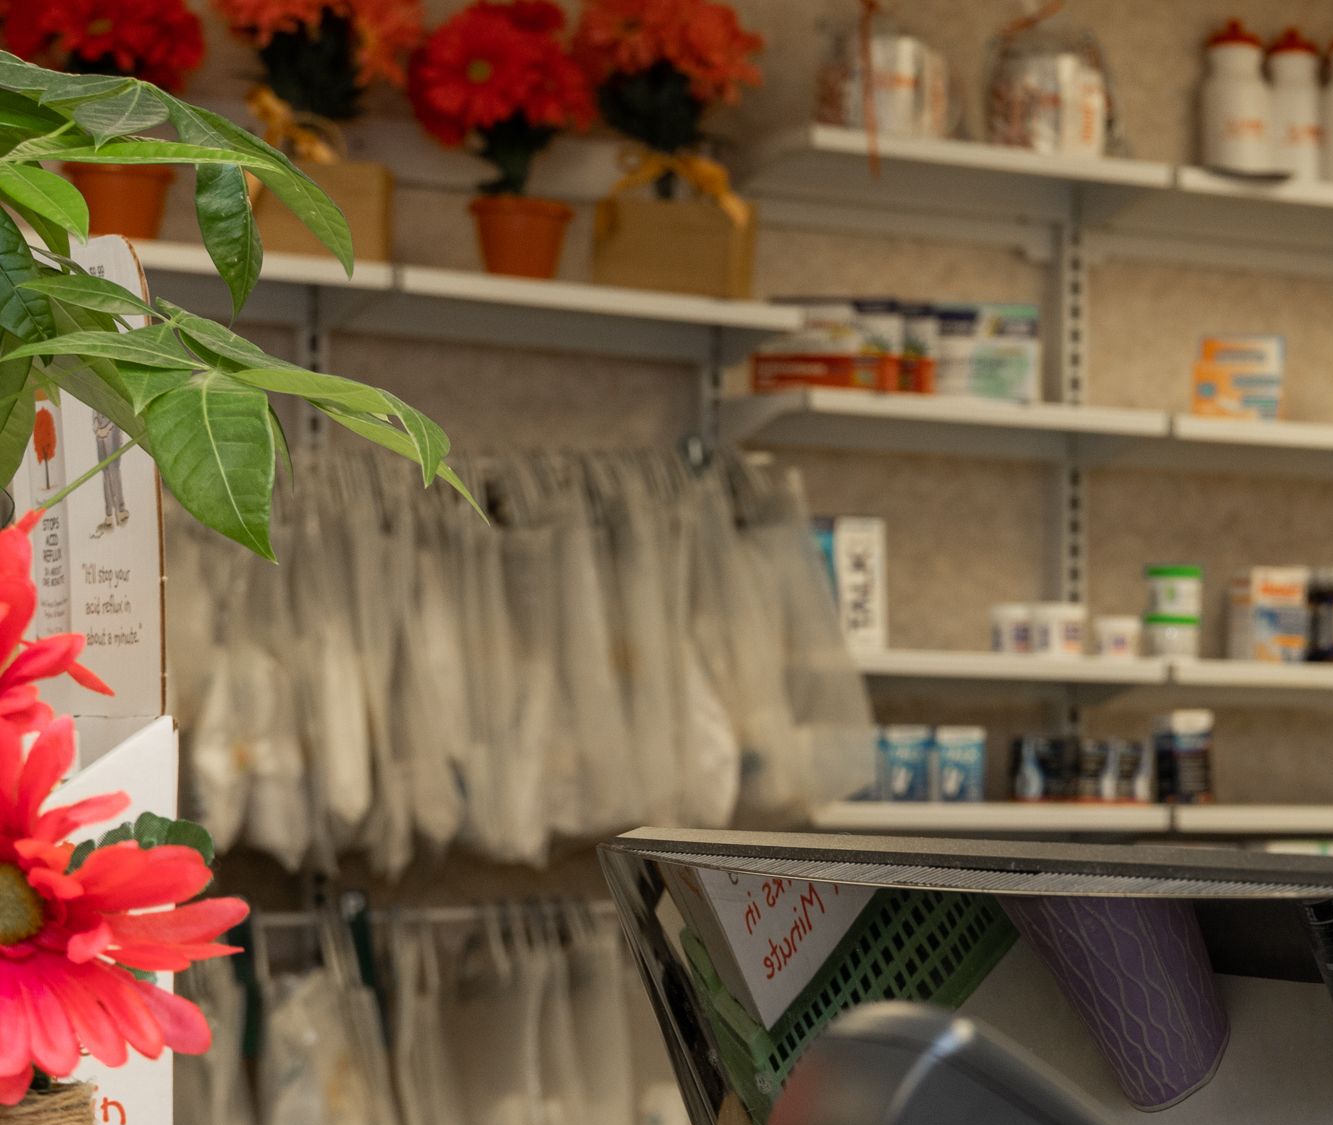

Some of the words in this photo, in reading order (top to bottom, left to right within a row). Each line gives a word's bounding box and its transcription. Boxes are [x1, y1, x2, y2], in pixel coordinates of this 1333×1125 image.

[98, 566, 113, 588] stop
[113, 569, 131, 588] your
[85, 596, 100, 615] acid
[102, 594, 123, 615] reflux
[124, 594, 132, 614] in
[86, 626, 106, 646] about
